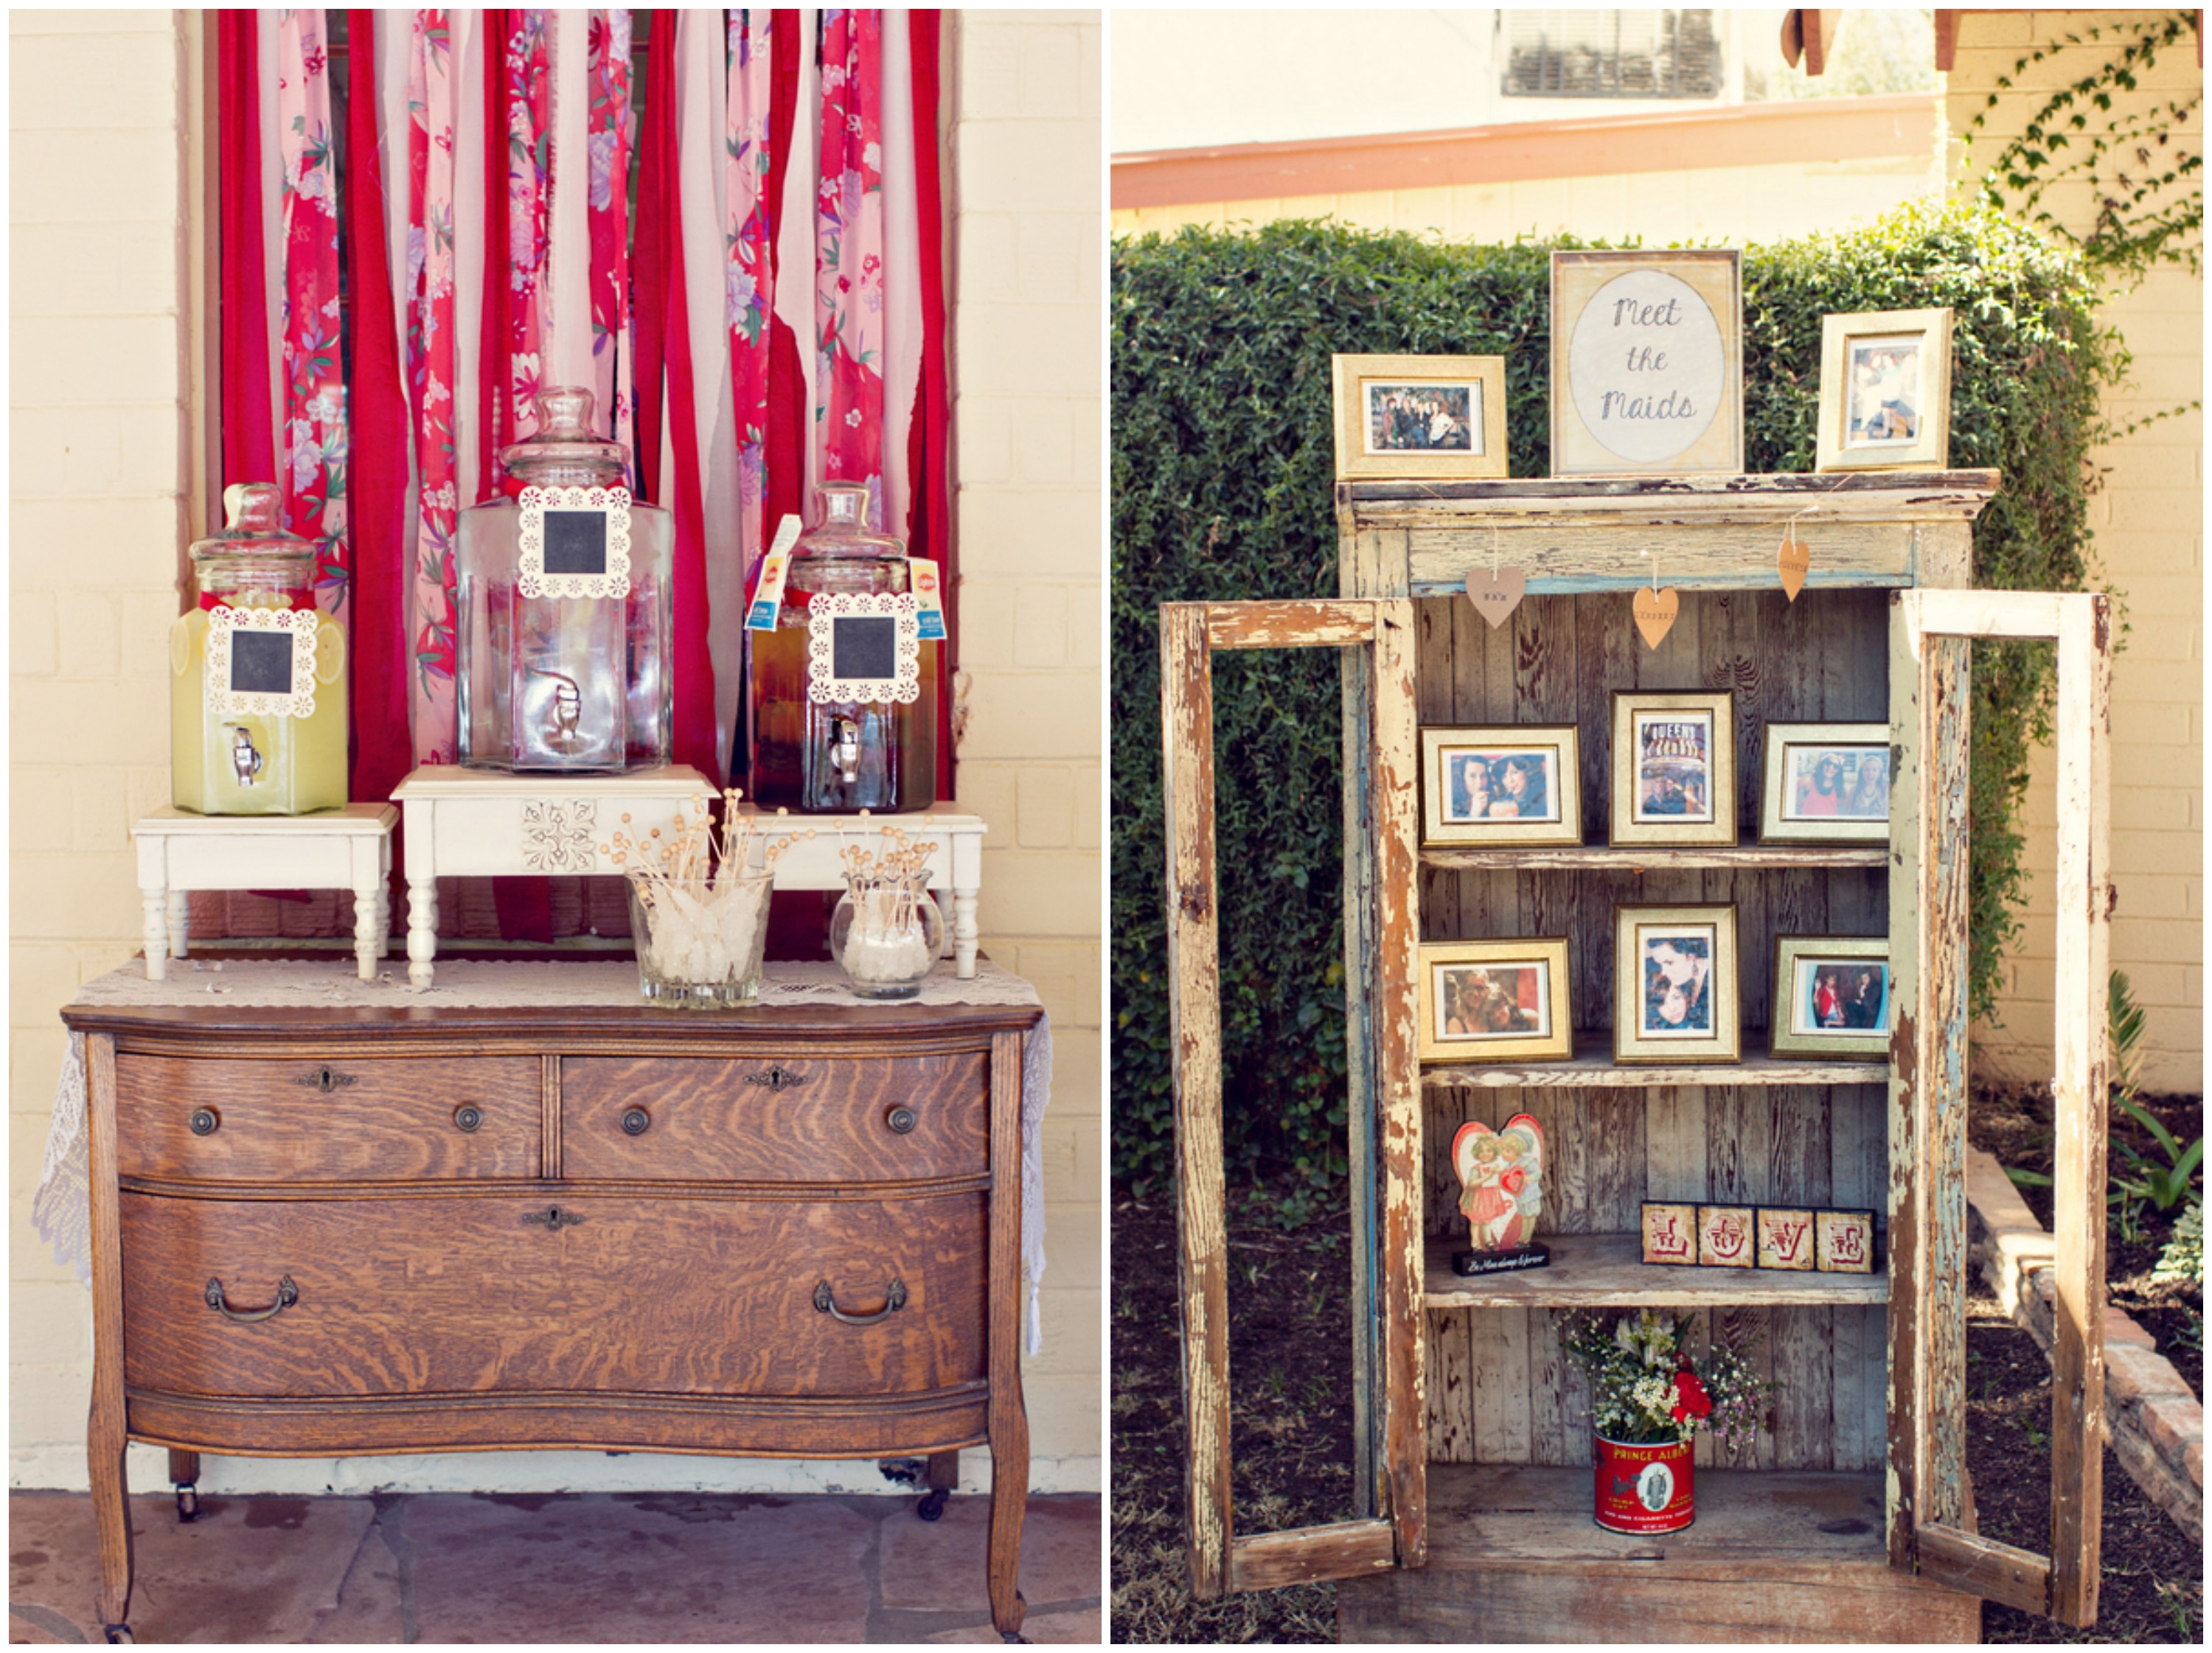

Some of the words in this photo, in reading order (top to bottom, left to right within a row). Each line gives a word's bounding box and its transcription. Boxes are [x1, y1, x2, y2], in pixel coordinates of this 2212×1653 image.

[1613, 297, 1682, 327] Meet
[1626, 346, 1669, 372] the
[1601, 389, 1697, 420] Maids
[1651, 1213, 1864, 1264] LOVE
[1613, 1446, 1653, 1461] PRINCE
